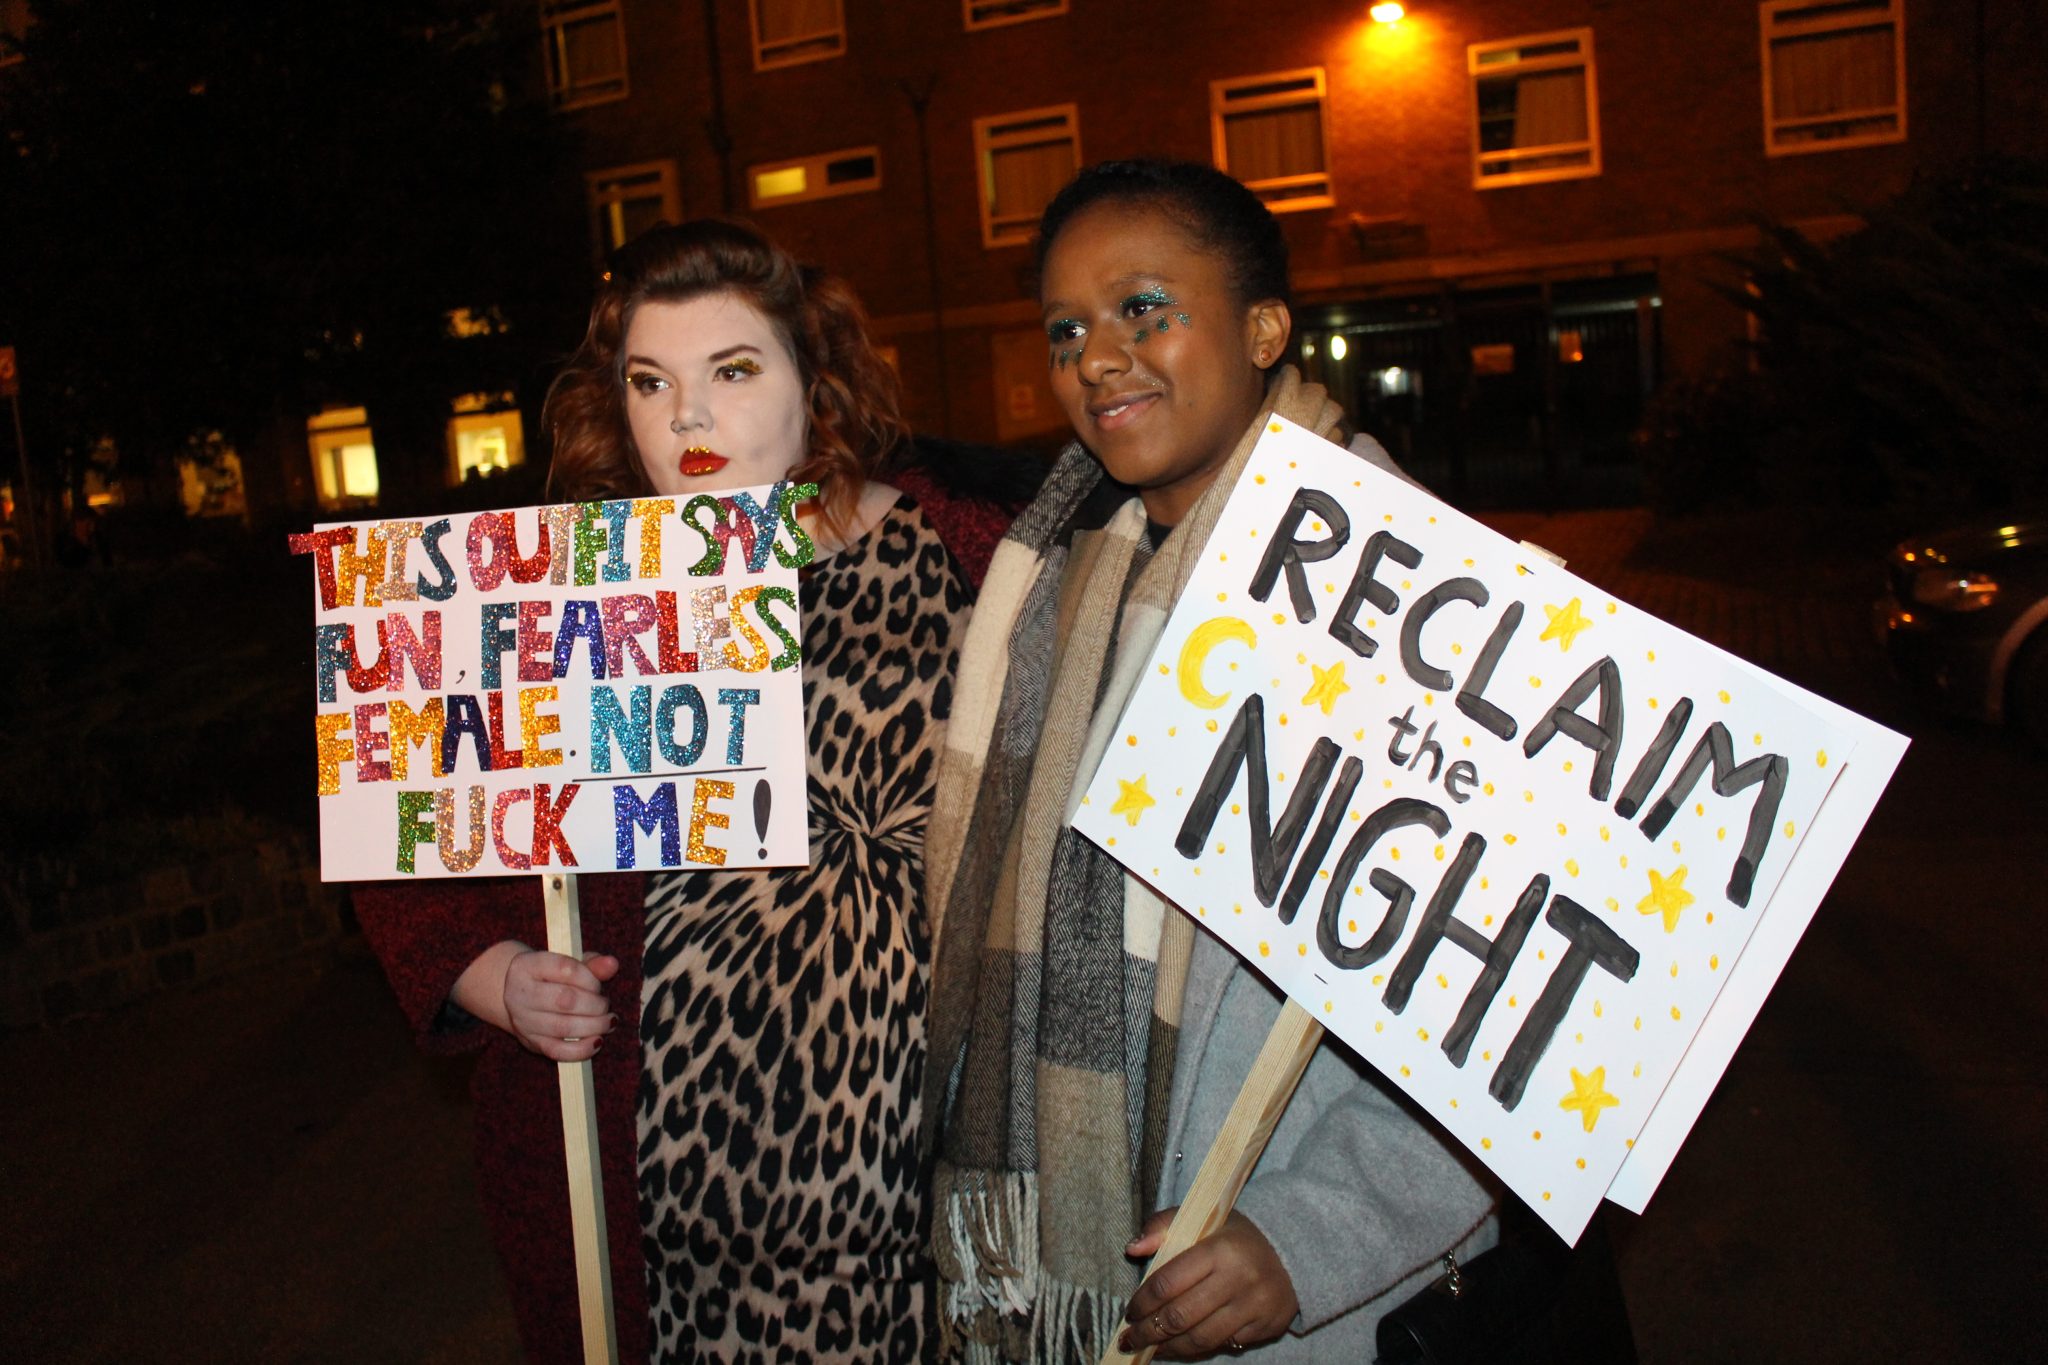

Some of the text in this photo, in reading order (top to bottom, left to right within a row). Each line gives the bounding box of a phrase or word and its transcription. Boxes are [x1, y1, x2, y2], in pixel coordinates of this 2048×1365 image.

[289, 480, 819, 612] THIS OUTFIT SAYS
[316, 683, 761, 797] FEMALE. NOT
[1248, 486, 1789, 909] RECLAIM
[1387, 705, 1480, 803] the
[396, 778, 772, 875] FUCK ME!
[1174, 693, 1641, 1112] NIGHT
